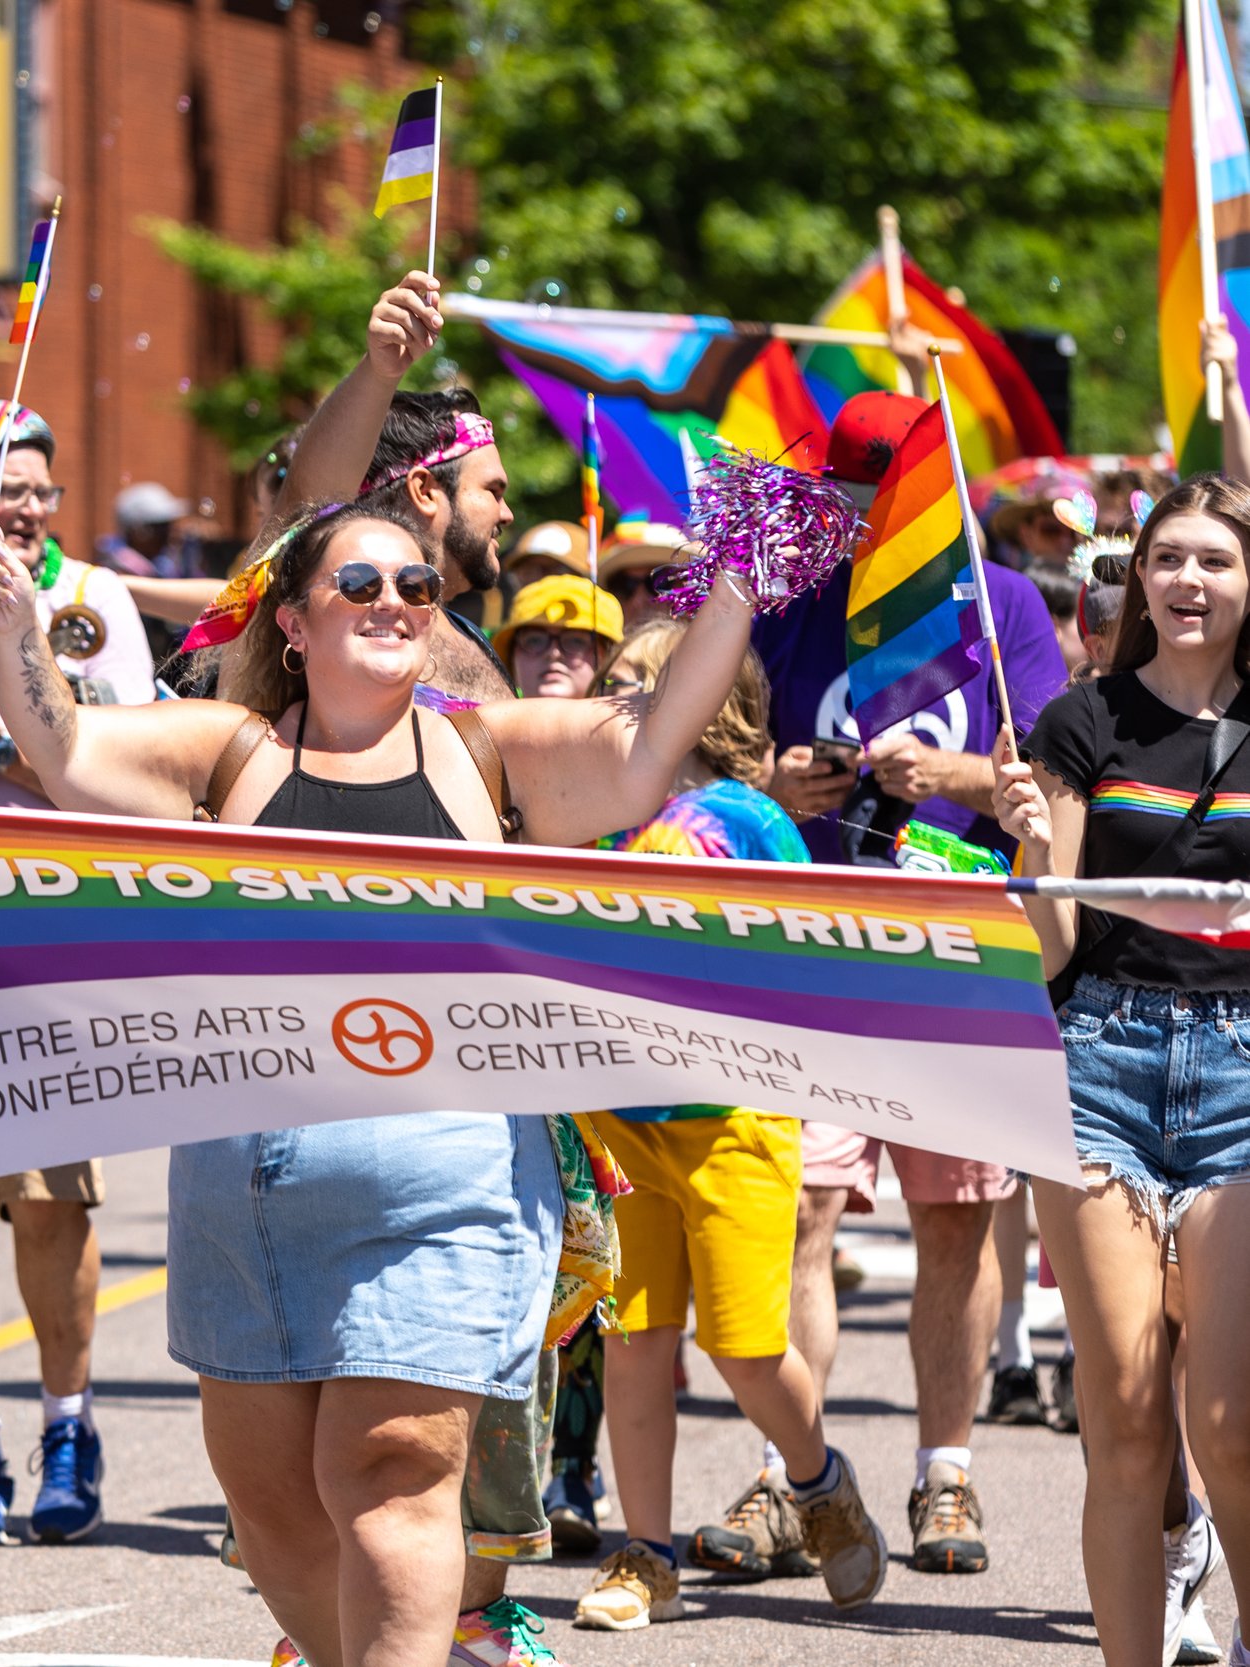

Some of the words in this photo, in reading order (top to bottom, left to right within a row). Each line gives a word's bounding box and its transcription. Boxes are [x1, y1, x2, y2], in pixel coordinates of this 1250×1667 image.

[92, 860, 213, 899] TO
[231, 867, 485, 909] SHOW
[511, 885, 705, 932] OUR
[718, 900, 983, 964] PRIDE
[92, 1012, 179, 1047] DES
[192, 1005, 306, 1039] ARTS
[446, 1002, 805, 1073] CONFEDERATION
[456, 1042, 635, 1073] CENTRE
[647, 1045, 701, 1069] OF
[709, 1058, 796, 1093] THE
[808, 1083, 914, 1123] ARTS
